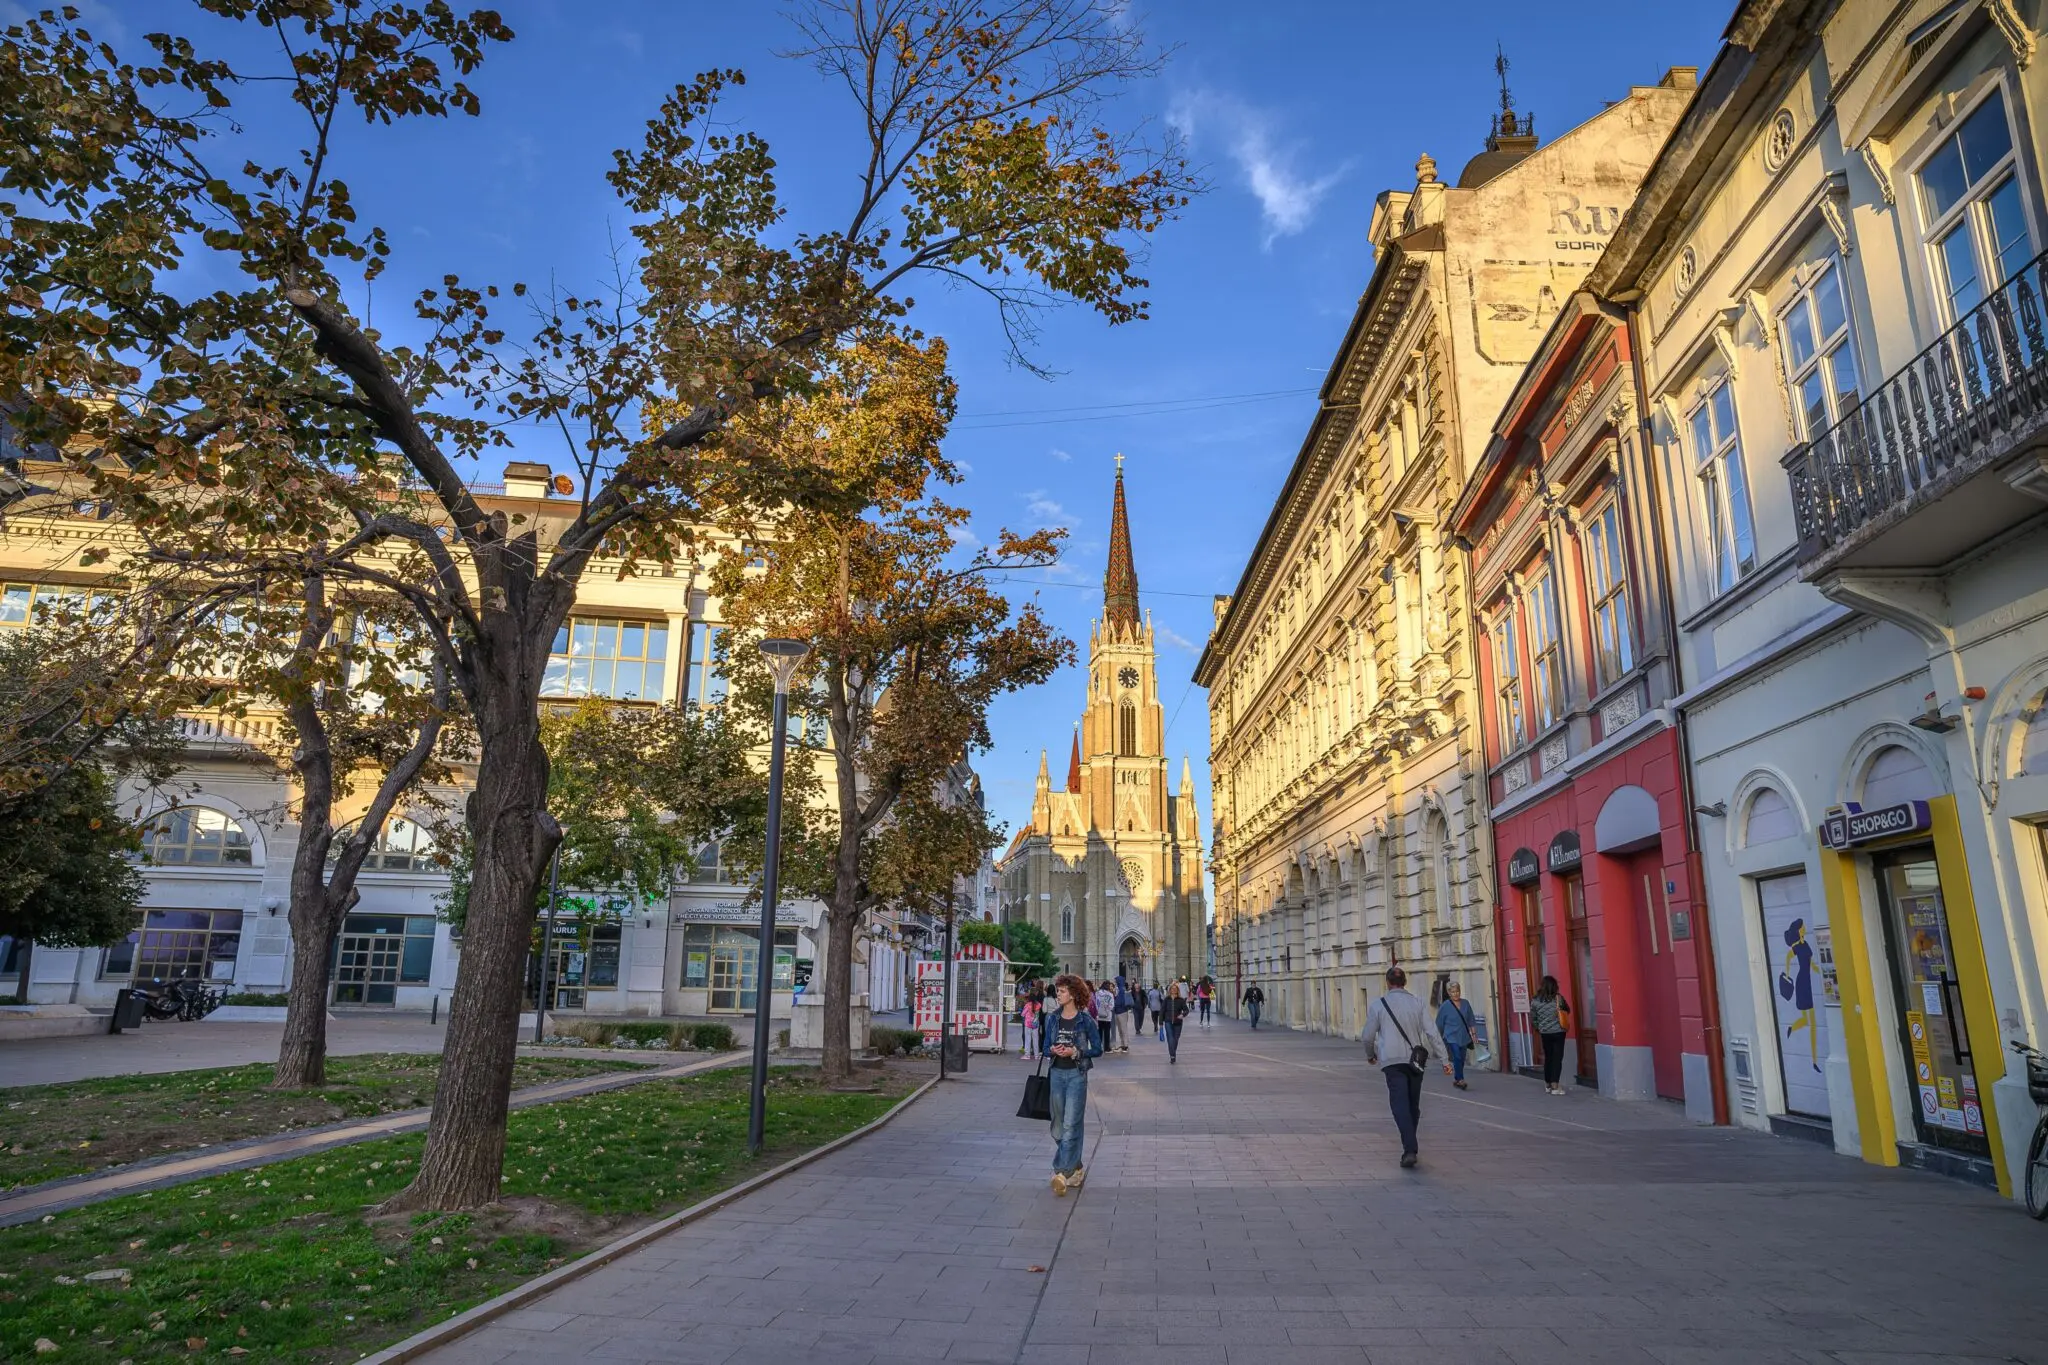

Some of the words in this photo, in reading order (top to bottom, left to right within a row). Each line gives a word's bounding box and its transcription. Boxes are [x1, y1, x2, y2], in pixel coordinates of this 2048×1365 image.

[1543, 191, 1628, 236] Ru
[1851, 809, 1907, 835] SHOP&GO
[1561, 848, 1580, 863] LONDON
[1520, 863, 1535, 876] LONDON
[552, 926, 578, 934] AURUS
